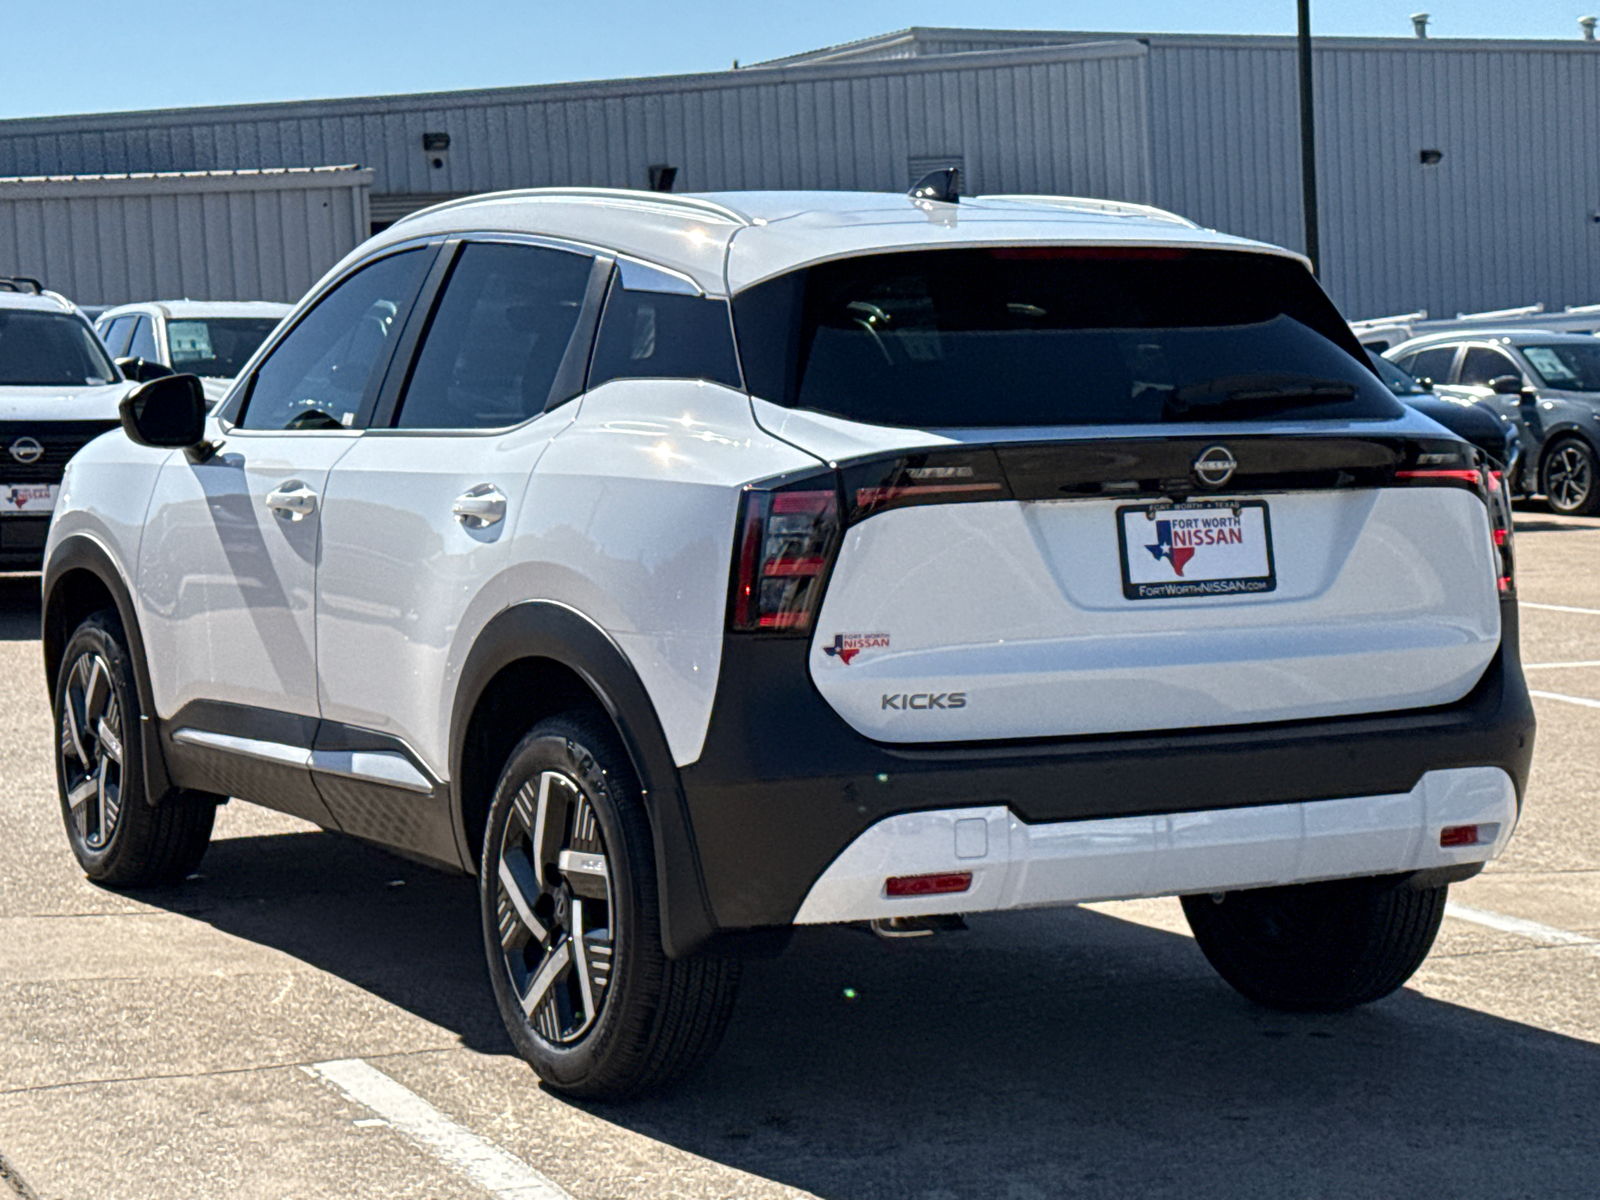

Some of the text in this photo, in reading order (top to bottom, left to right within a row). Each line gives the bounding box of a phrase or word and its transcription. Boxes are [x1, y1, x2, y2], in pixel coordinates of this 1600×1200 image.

[1172, 516, 1241, 529] FORT WORTH
[1173, 527, 1243, 547] NISSAN
[843, 638, 890, 648] NISSAN
[881, 692, 967, 711] KICKS
